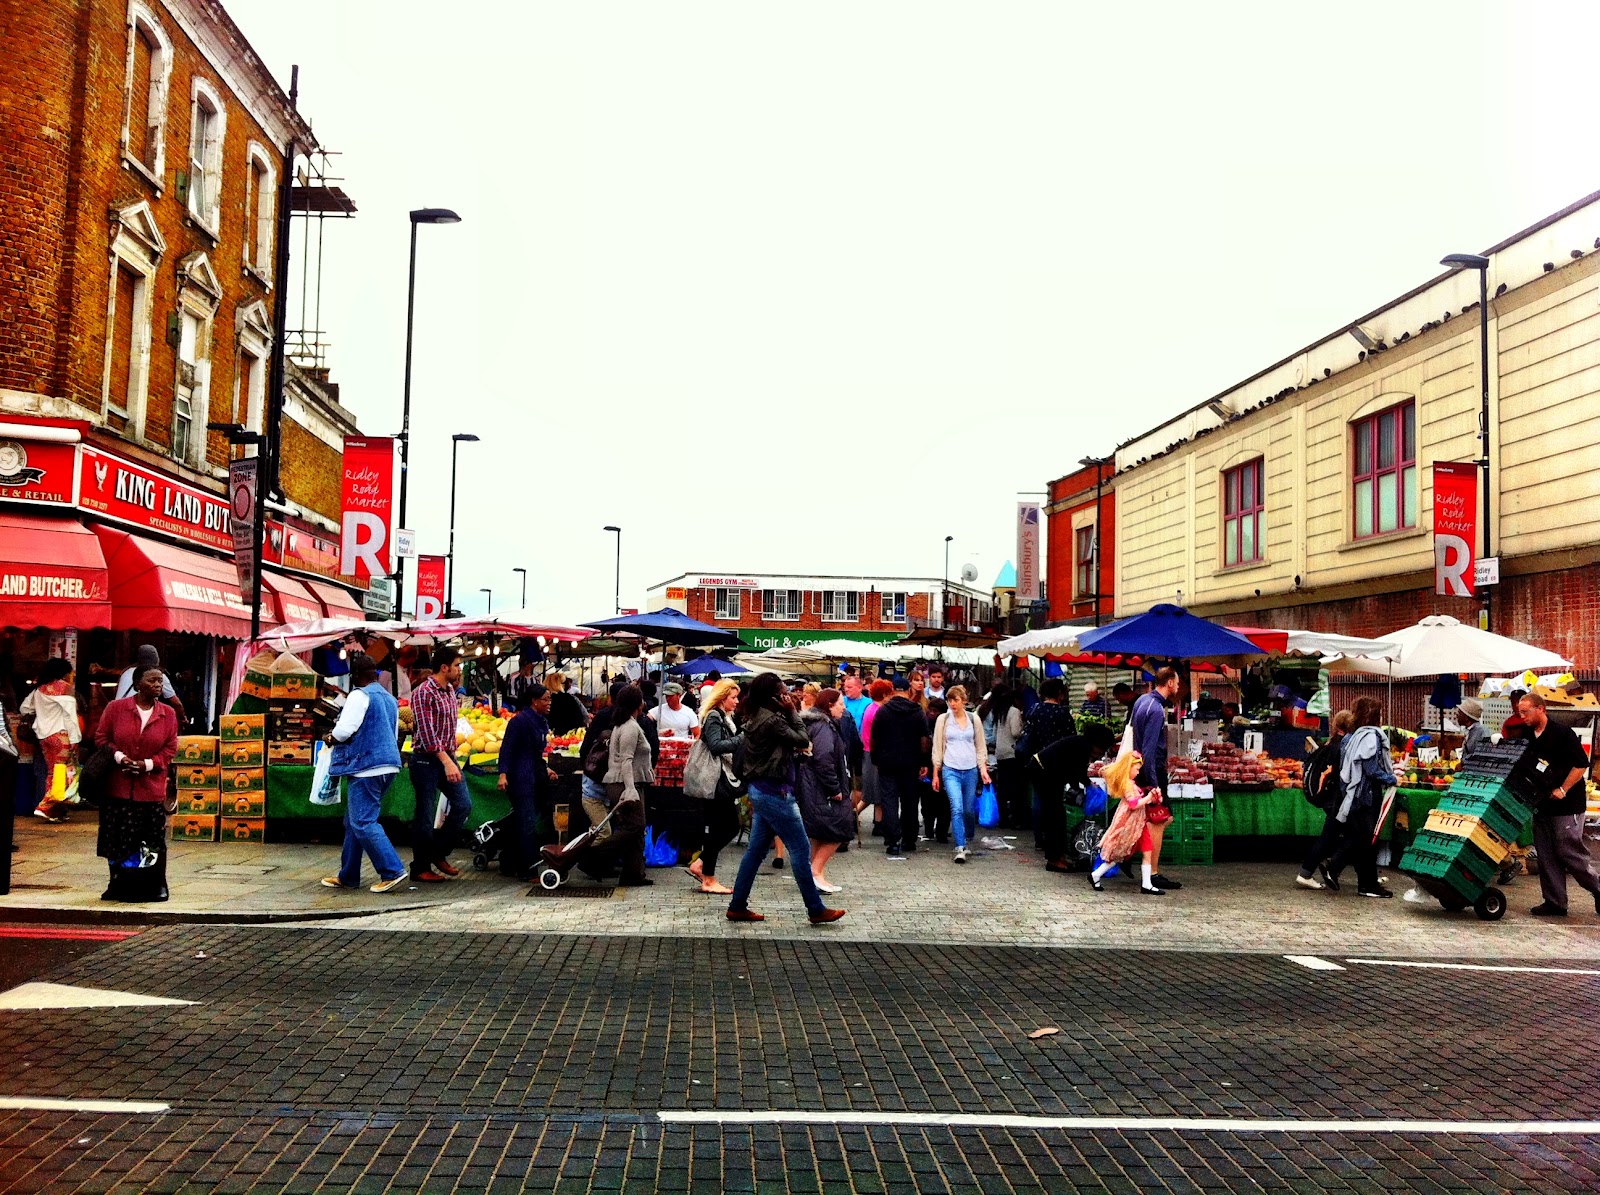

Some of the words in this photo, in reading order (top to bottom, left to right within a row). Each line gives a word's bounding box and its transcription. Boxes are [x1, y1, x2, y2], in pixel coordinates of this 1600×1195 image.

[233, 472, 252, 483] ZONE
[345, 466, 380, 485] Ridley
[12, 489, 21, 498] &
[25, 490, 64, 502] RETAIL
[352, 483, 380, 495] Road
[115, 468, 157, 511] KING
[163, 486, 202, 525] LAND
[346, 495, 389, 508] Market
[1436, 491, 1465, 506] Ridley
[1442, 507, 1465, 519] Road
[149, 516, 183, 535] SPECIALISTS
[1438, 518, 1474, 532] Market
[341, 510, 387, 576] R
[1021, 530, 1034, 595] Sainsbury's
[1434, 533, 1474, 597] R
[419, 571, 438, 580] Ridley
[0, 574, 27, 596] AND
[667, 591, 683, 599] GYM
[754, 636, 779, 648] hair
[783, 636, 792, 648] &
